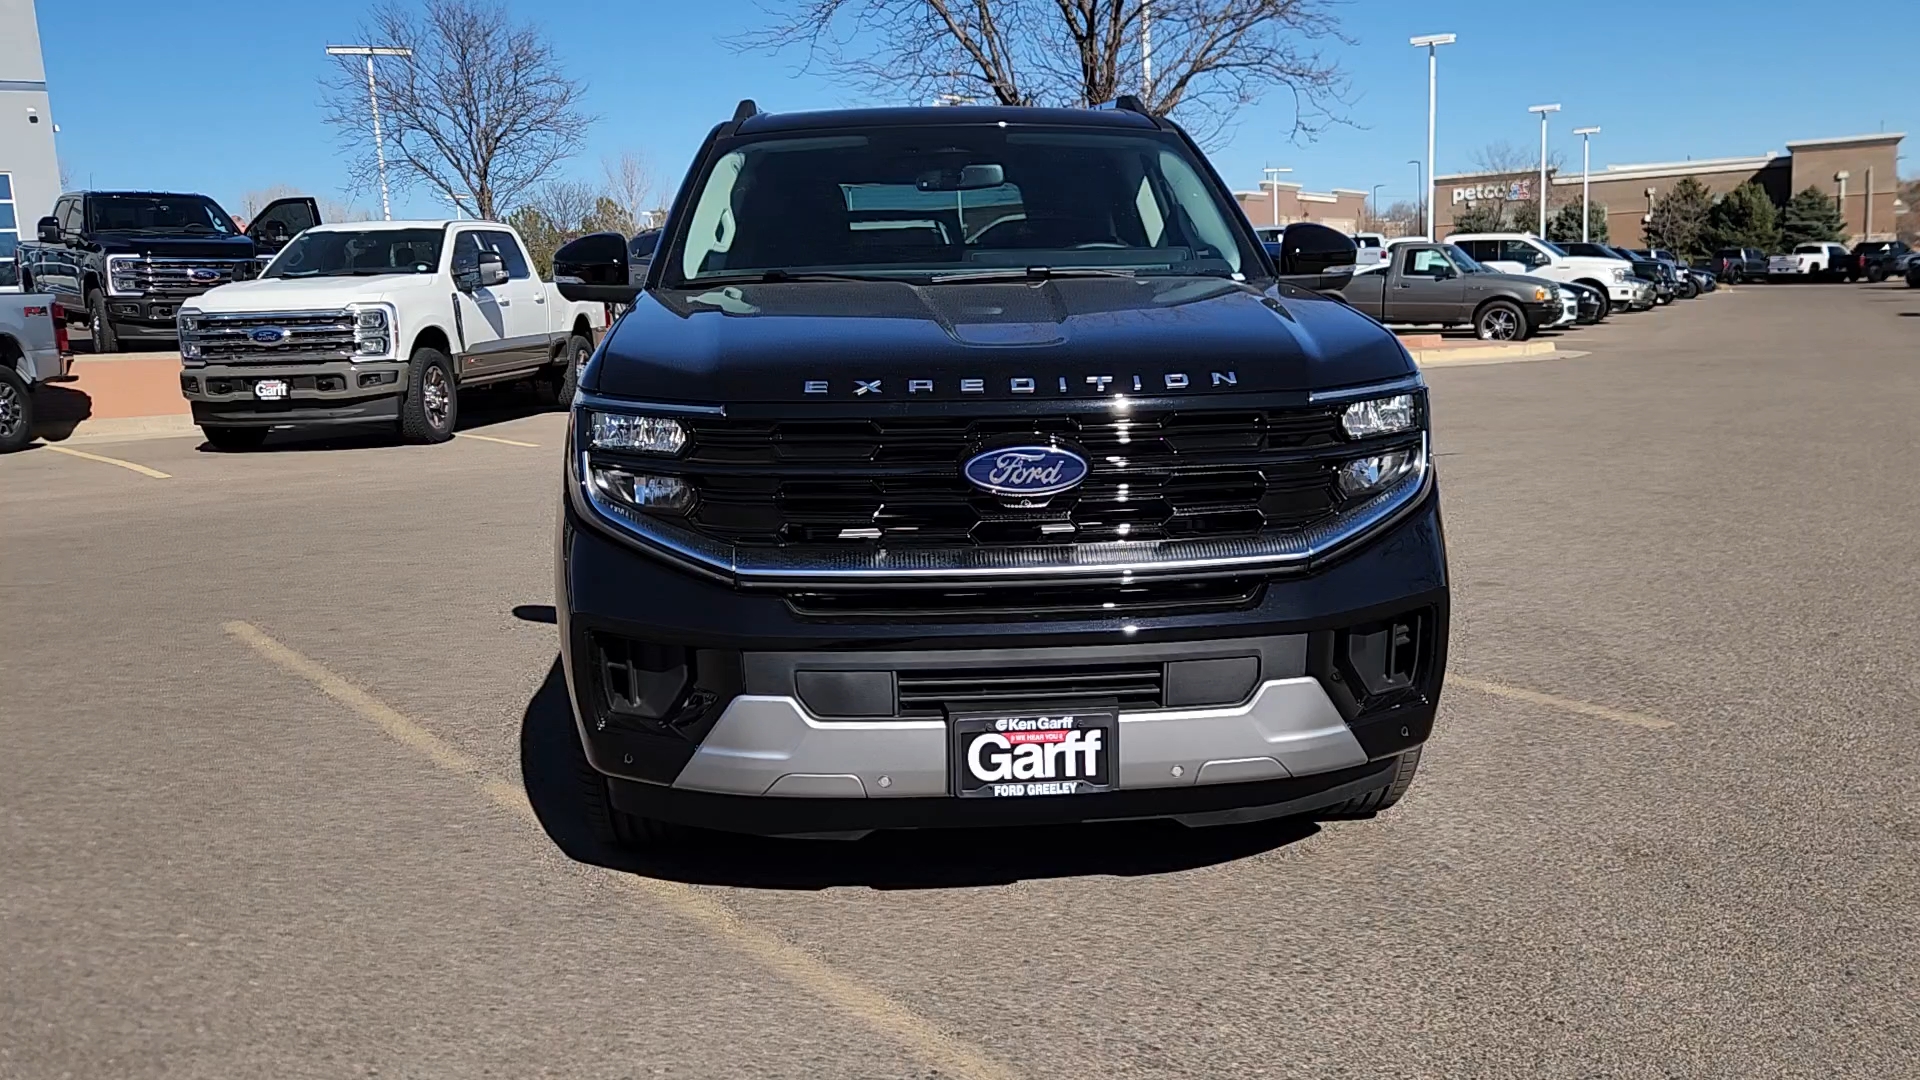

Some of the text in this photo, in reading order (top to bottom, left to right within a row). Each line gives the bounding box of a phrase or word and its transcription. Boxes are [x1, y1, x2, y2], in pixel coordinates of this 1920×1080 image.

[1453, 184, 1506, 205] petco
[255, 383, 288, 397] Garff
[803, 370, 1238, 396] EXPEDITION
[989, 451, 1063, 485] Ford
[1008, 718, 1037, 731] Ken
[1037, 716, 1074, 730] Garff
[1027, 733, 1044, 741] HEAR
[967, 729, 1102, 782] Garff
[994, 782, 1078, 797] FORD GREELEY
